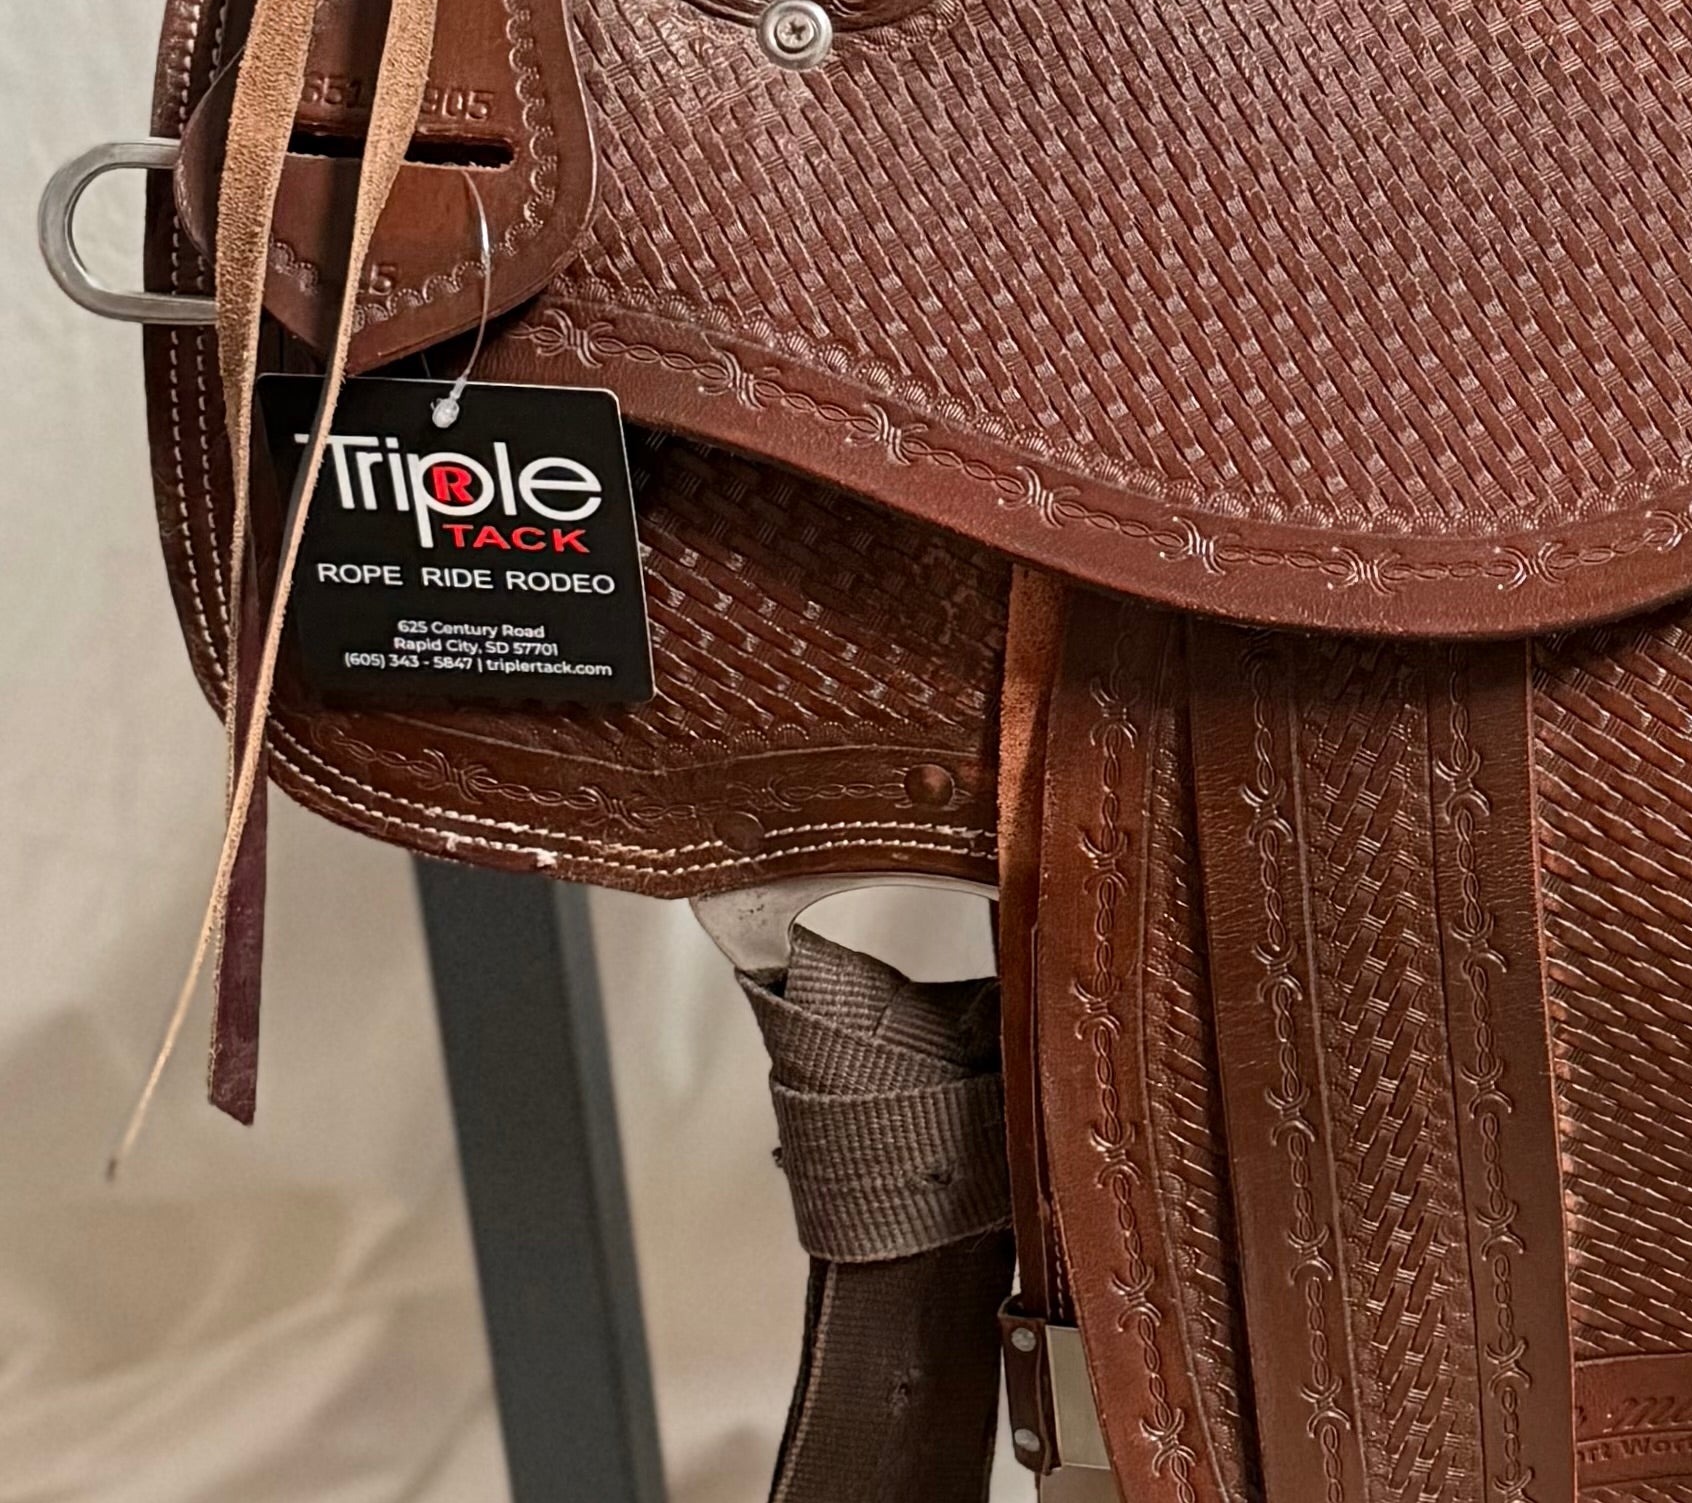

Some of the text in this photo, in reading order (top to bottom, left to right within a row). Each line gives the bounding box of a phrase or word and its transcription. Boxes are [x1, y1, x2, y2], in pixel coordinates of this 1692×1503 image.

[294, 433, 602, 548] Triple
[442, 523, 591, 554] TACK
[316, 562, 616, 594] ROPE RIDE RODEO
[397, 620, 545, 639] 625 Century Road
[393, 637, 559, 657] Rapid City, SD 57701
[344, 652, 386, 669] (605)
[388, 654, 419, 668] 343
[433, 655, 472, 670] 5847
[486, 659, 613, 677] triplertack.com
